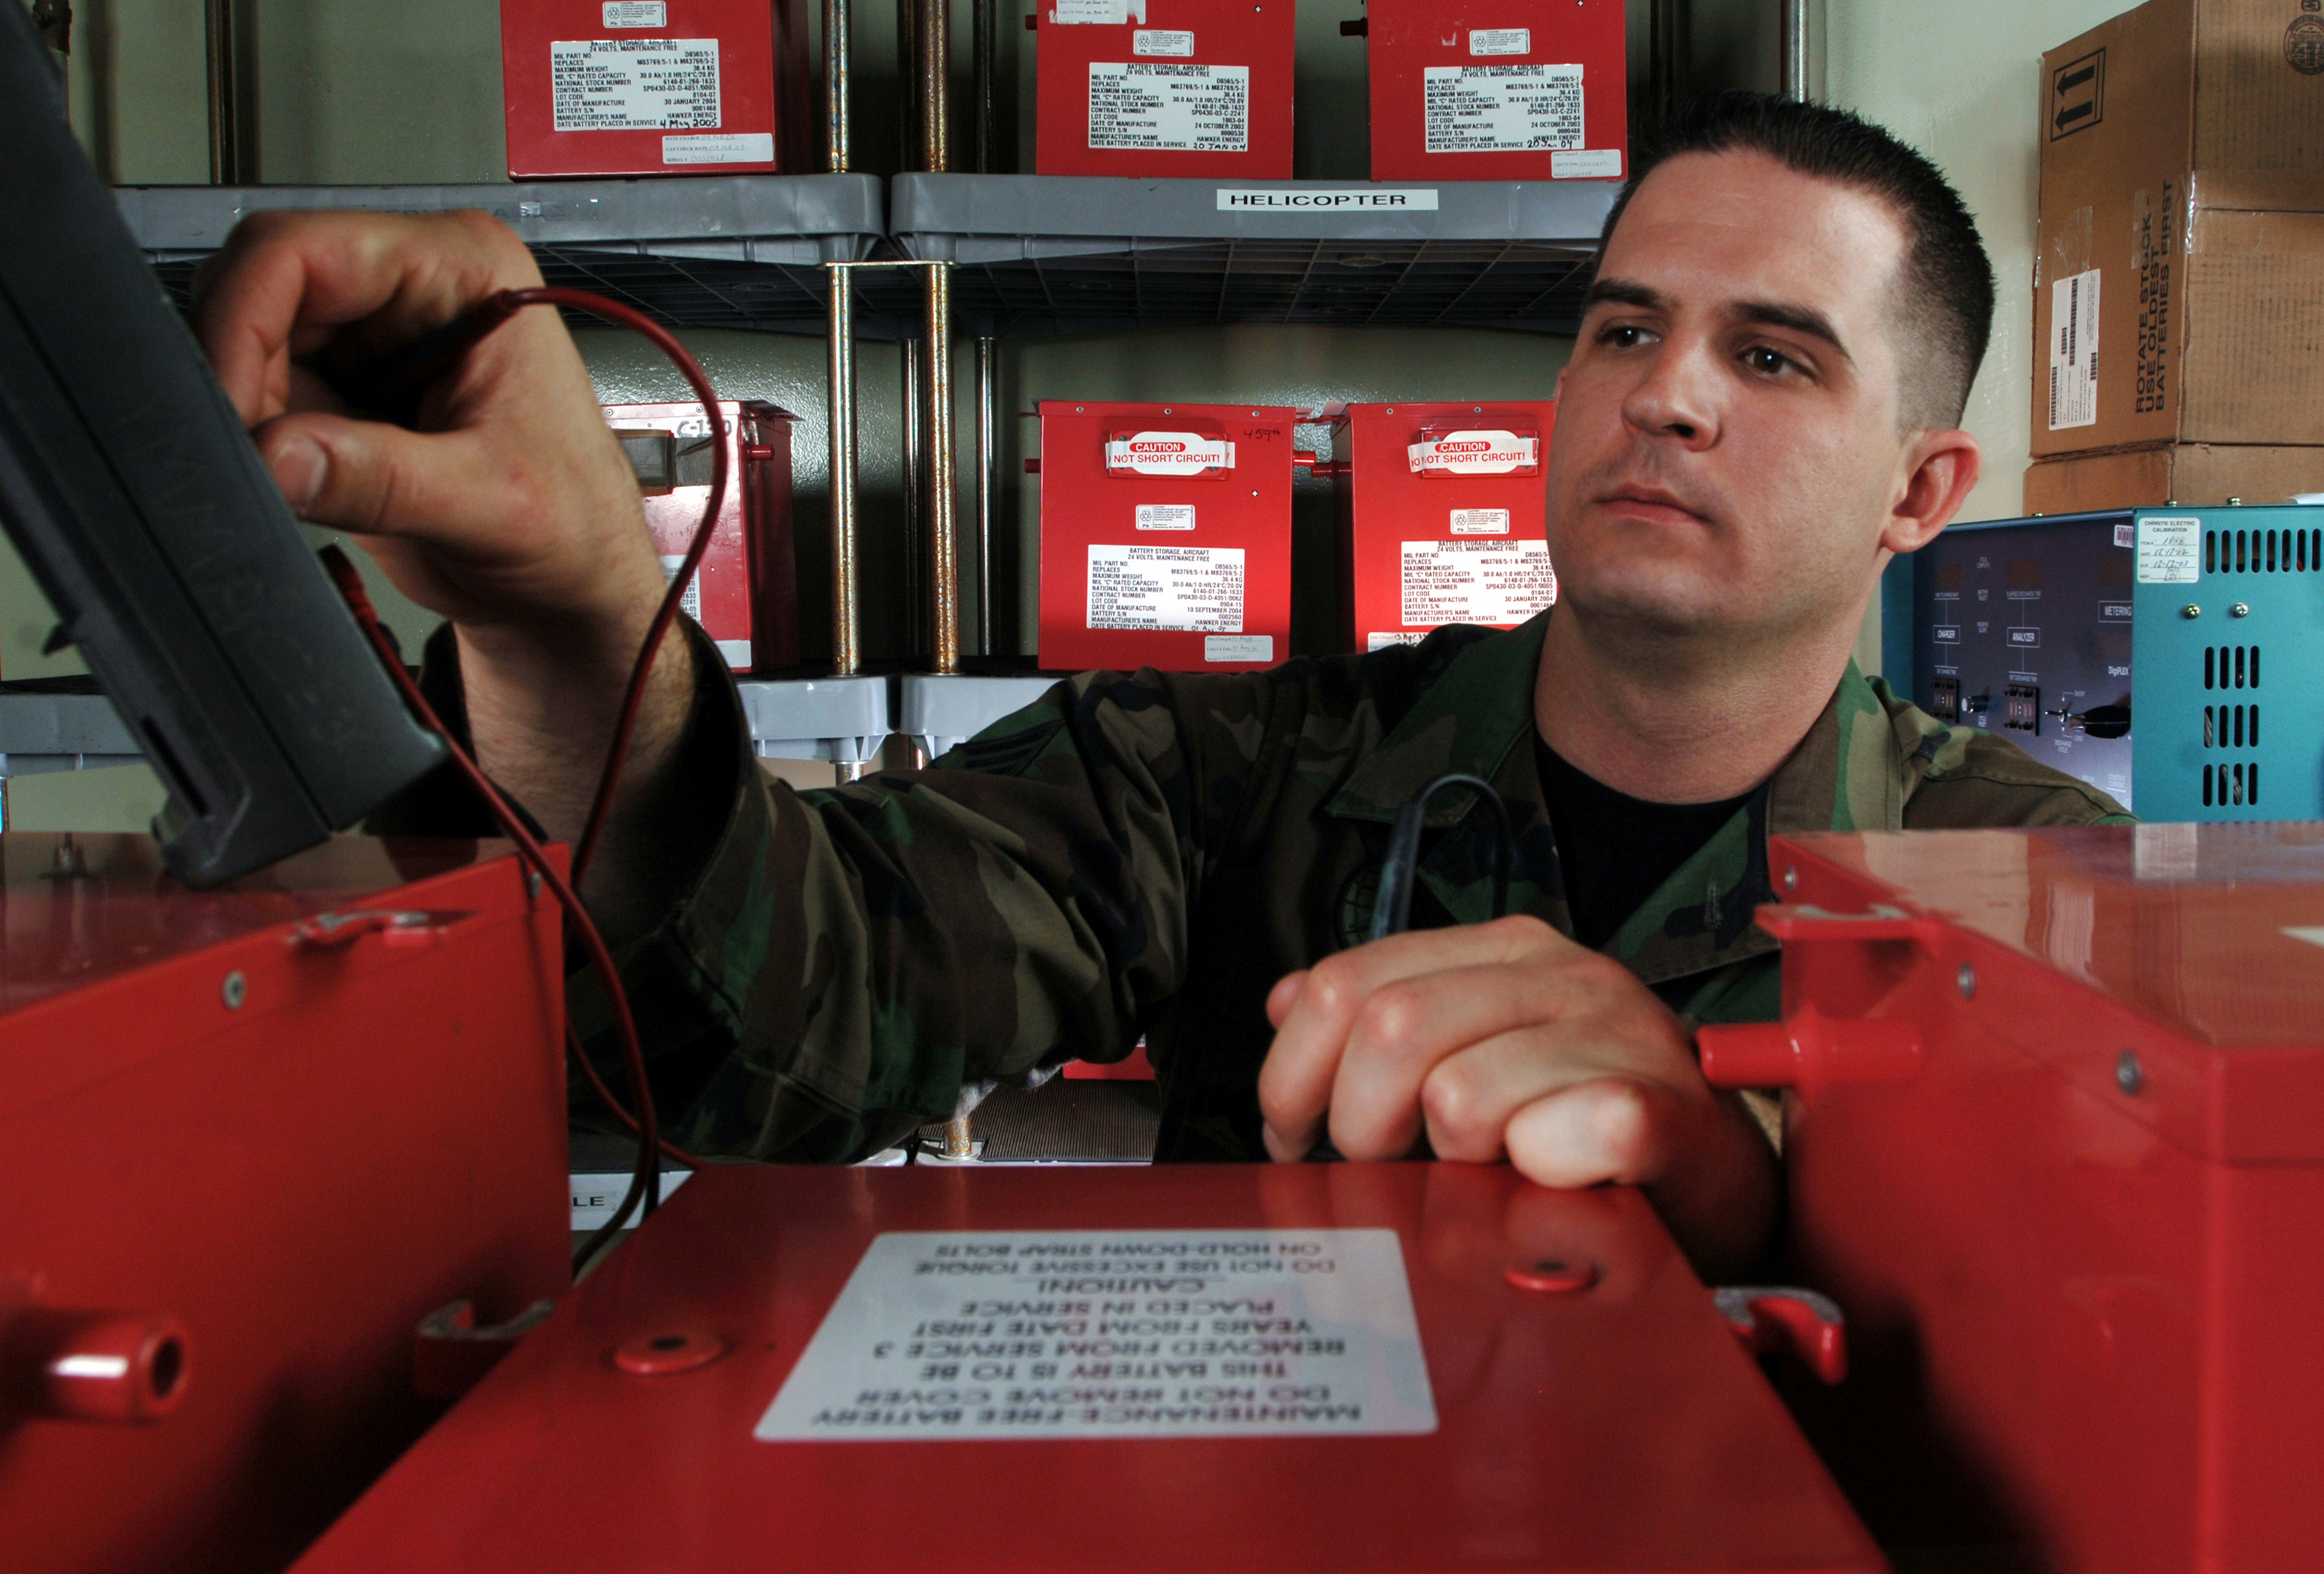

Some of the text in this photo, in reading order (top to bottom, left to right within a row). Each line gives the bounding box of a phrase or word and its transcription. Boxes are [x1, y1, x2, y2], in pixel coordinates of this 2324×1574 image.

[660, 119, 666, 129] 4
[669, 119, 689, 129] May
[1230, 195, 1407, 206] HELICOPTER
[2140, 212, 2151, 304] STOCK
[2156, 180, 2172, 411] BATTERIES FIRST
[2146, 246, 2160, 412] USE OLDEST
[2137, 313, 2147, 413] ROTATE
[677, 419, 733, 438] C-10
[1136, 443, 1181, 452] CAUTION
[1440, 442, 1486, 452] CAUTION
[1114, 455, 1134, 463] NOT
[1176, 454, 1220, 462] CIRCUIT!
[1443, 454, 1479, 462] SHORT
[1481, 452, 1525, 462] CIRCUIT!
[2105, 606, 2132, 616] METERING
[2012, 632, 2035, 642] ANALYZER
[934, 1245, 1011, 1258] BOLTS
[1018, 1244, 1092, 1256] STRAP
[1278, 1244, 1320, 1256] ON
[913, 1260, 1335, 1275] DO NOT USE EXCESSIVE TORQUE
[1037, 1278, 1205, 1294] CAUTION!
[961, 1300, 1274, 1317] PLACED IN SERVICE
[913, 1318, 1312, 1337] YEARS FROM DATE FIRST
[906, 1341, 1044, 1359] SERVICE
[1055, 1340, 1159, 1357] FROM
[1171, 1339, 1345, 1356] REMOVED
[919, 1362, 1286, 1382] THIS BATTERY IS TO BE
[855, 1386, 1331, 1405] DO NOT REMOVE COVER
[811, 1409, 964, 1426] BATTERY
